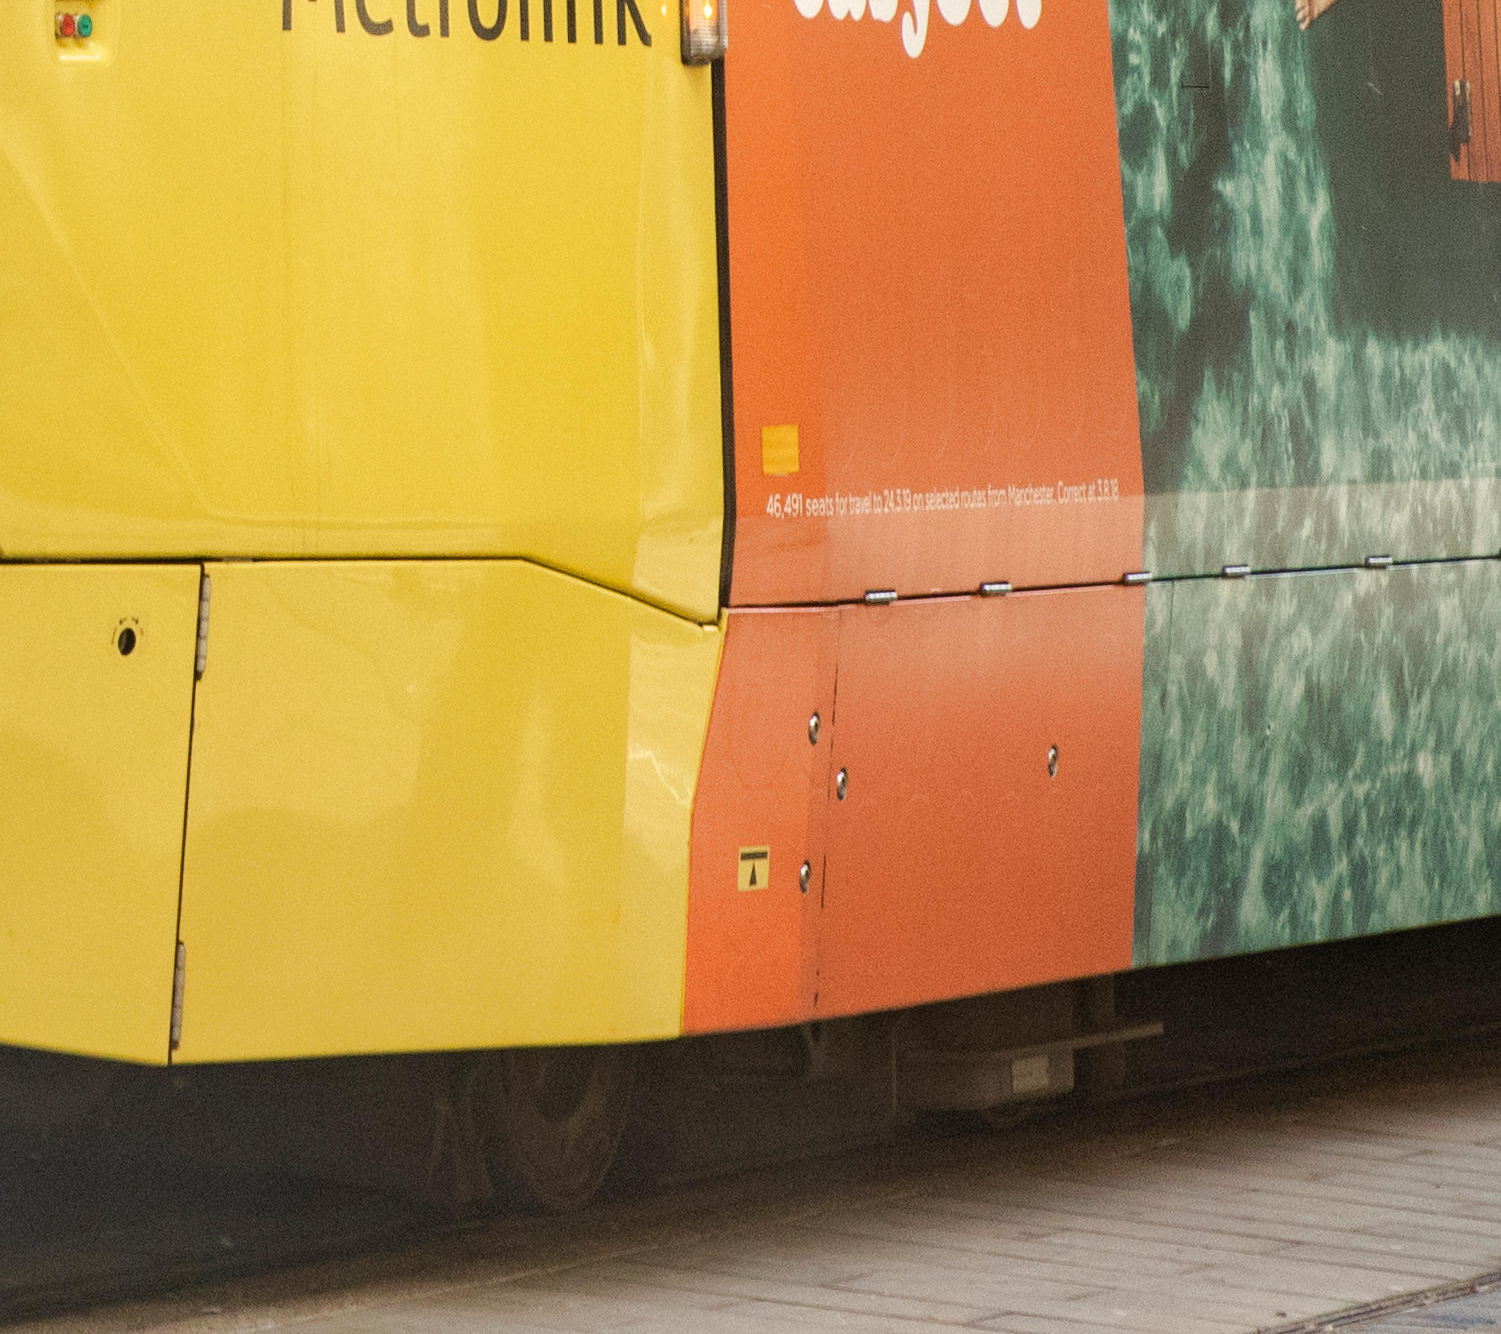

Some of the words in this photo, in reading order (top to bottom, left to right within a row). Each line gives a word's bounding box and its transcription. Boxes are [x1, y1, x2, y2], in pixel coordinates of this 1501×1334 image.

[765, 492, 804, 521] 46,491
[805, 495, 835, 517] seats
[835, 491, 847, 515] for
[848, 491, 872, 515] travel
[873, 492, 883, 515] to
[912, 492, 924, 511] on
[925, 487, 960, 511] selected
[960, 488, 986, 510] routes
[987, 483, 1007, 508] from
[1057, 480, 1086, 505] Correct
[1087, 483, 1096, 503] at
